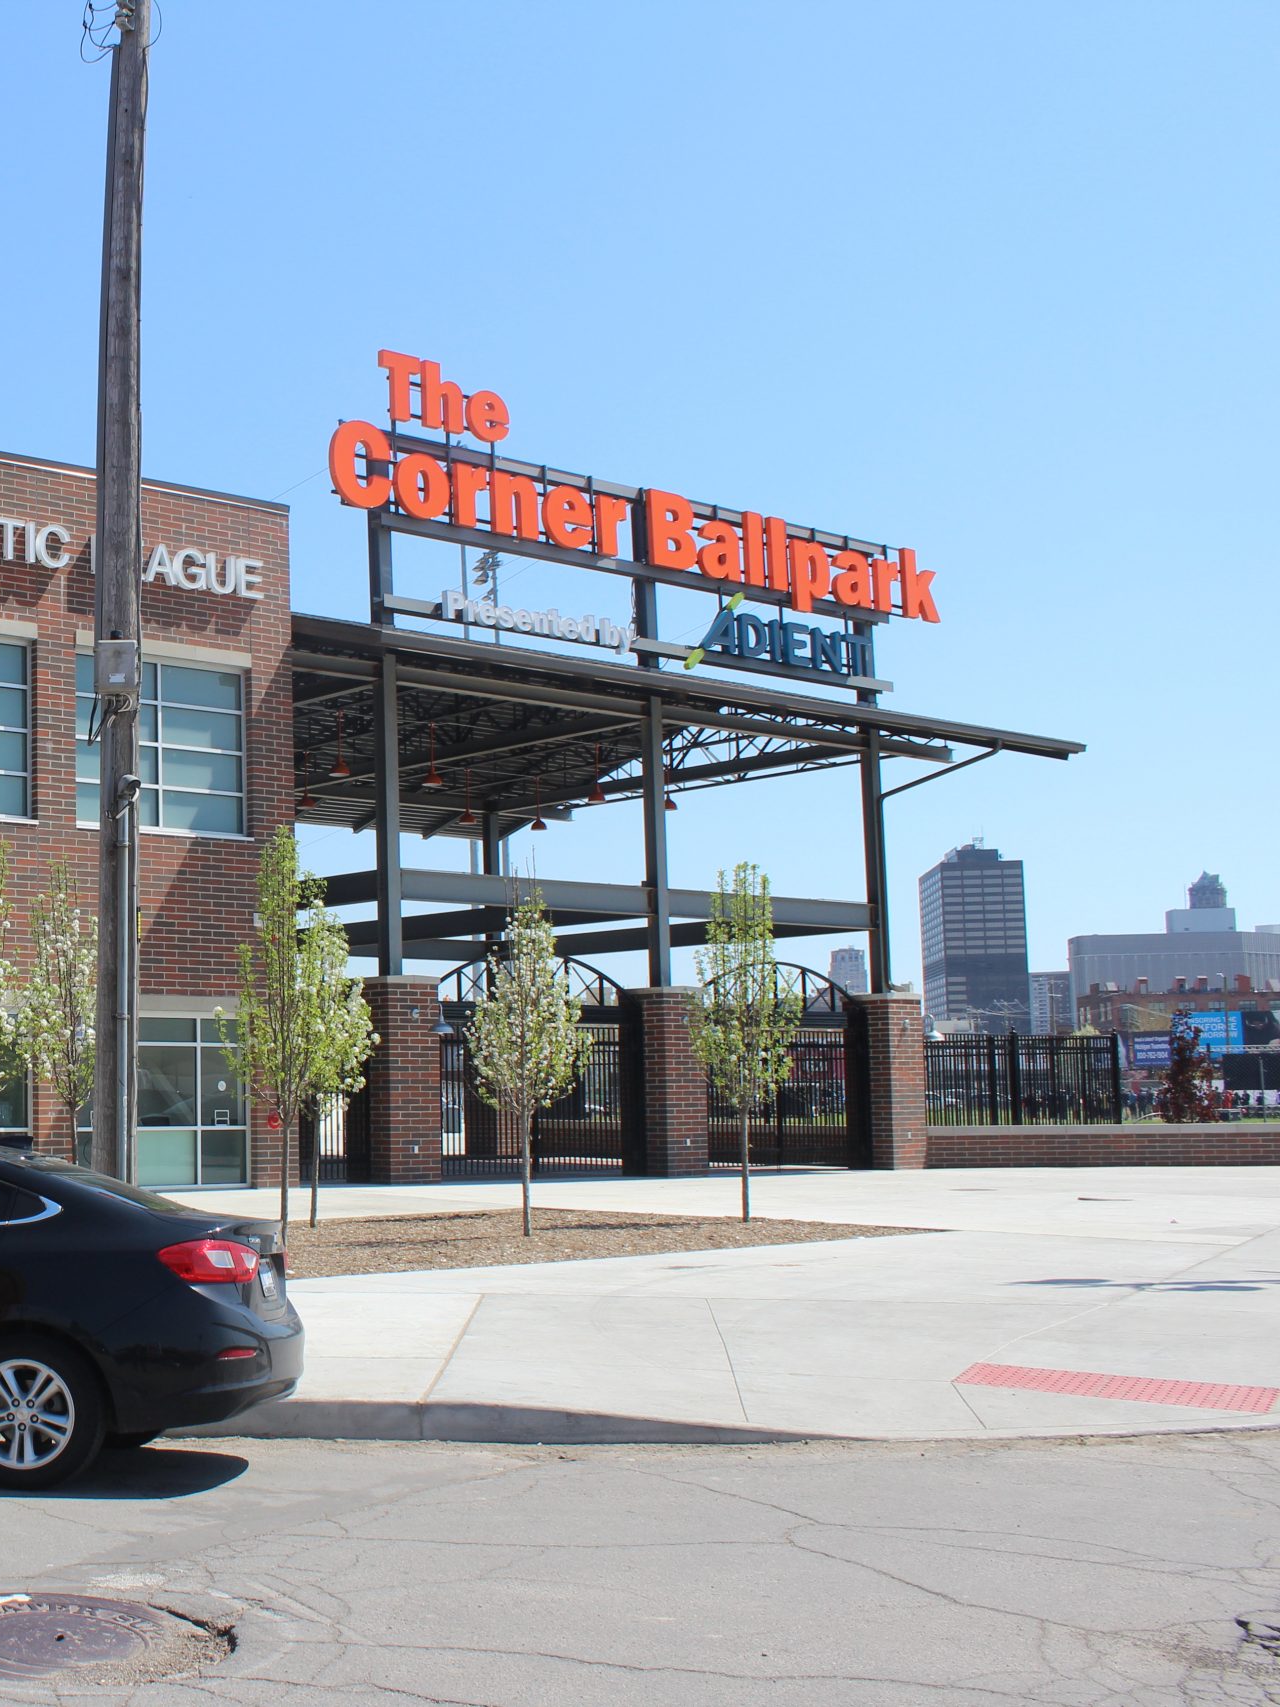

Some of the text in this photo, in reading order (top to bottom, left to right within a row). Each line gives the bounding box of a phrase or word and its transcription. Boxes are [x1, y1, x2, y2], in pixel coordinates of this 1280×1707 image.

[377, 348, 510, 442] The
[329, 419, 941, 624] Corner Ballpark
[91, 532, 265, 600] AGUE
[441, 589, 638, 656] Presented by
[694, 602, 872, 677] ADIENT
